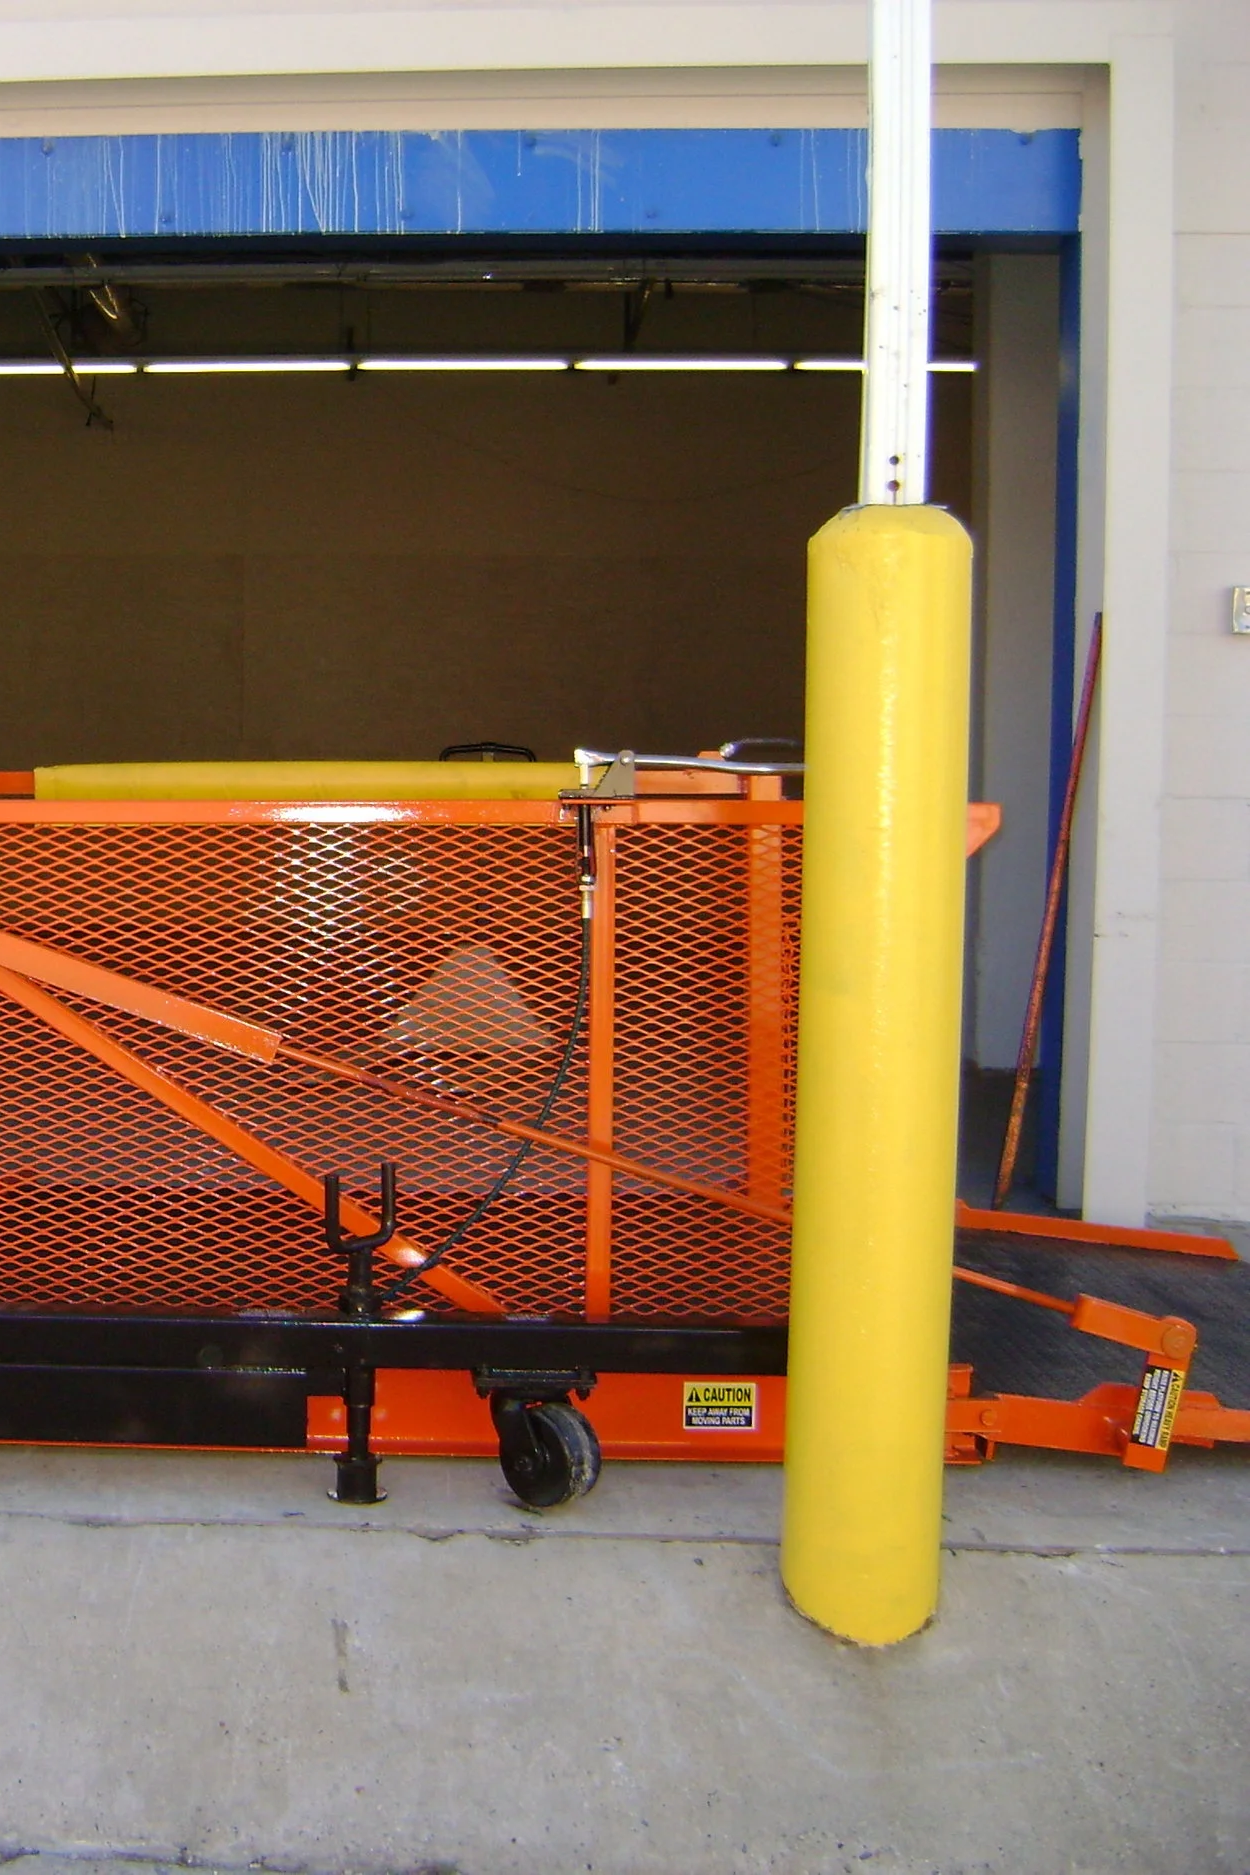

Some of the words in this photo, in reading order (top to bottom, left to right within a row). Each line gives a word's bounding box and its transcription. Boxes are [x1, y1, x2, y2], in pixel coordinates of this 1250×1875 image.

[703, 1388, 751, 1402] CAUTION
[687, 1407, 707, 1416] KEEP
[707, 1407, 728, 1416] AWAY
[729, 1407, 750, 1416] FROM
[691, 1416, 720, 1425] MOVING
[721, 1416, 746, 1425] PARTS
